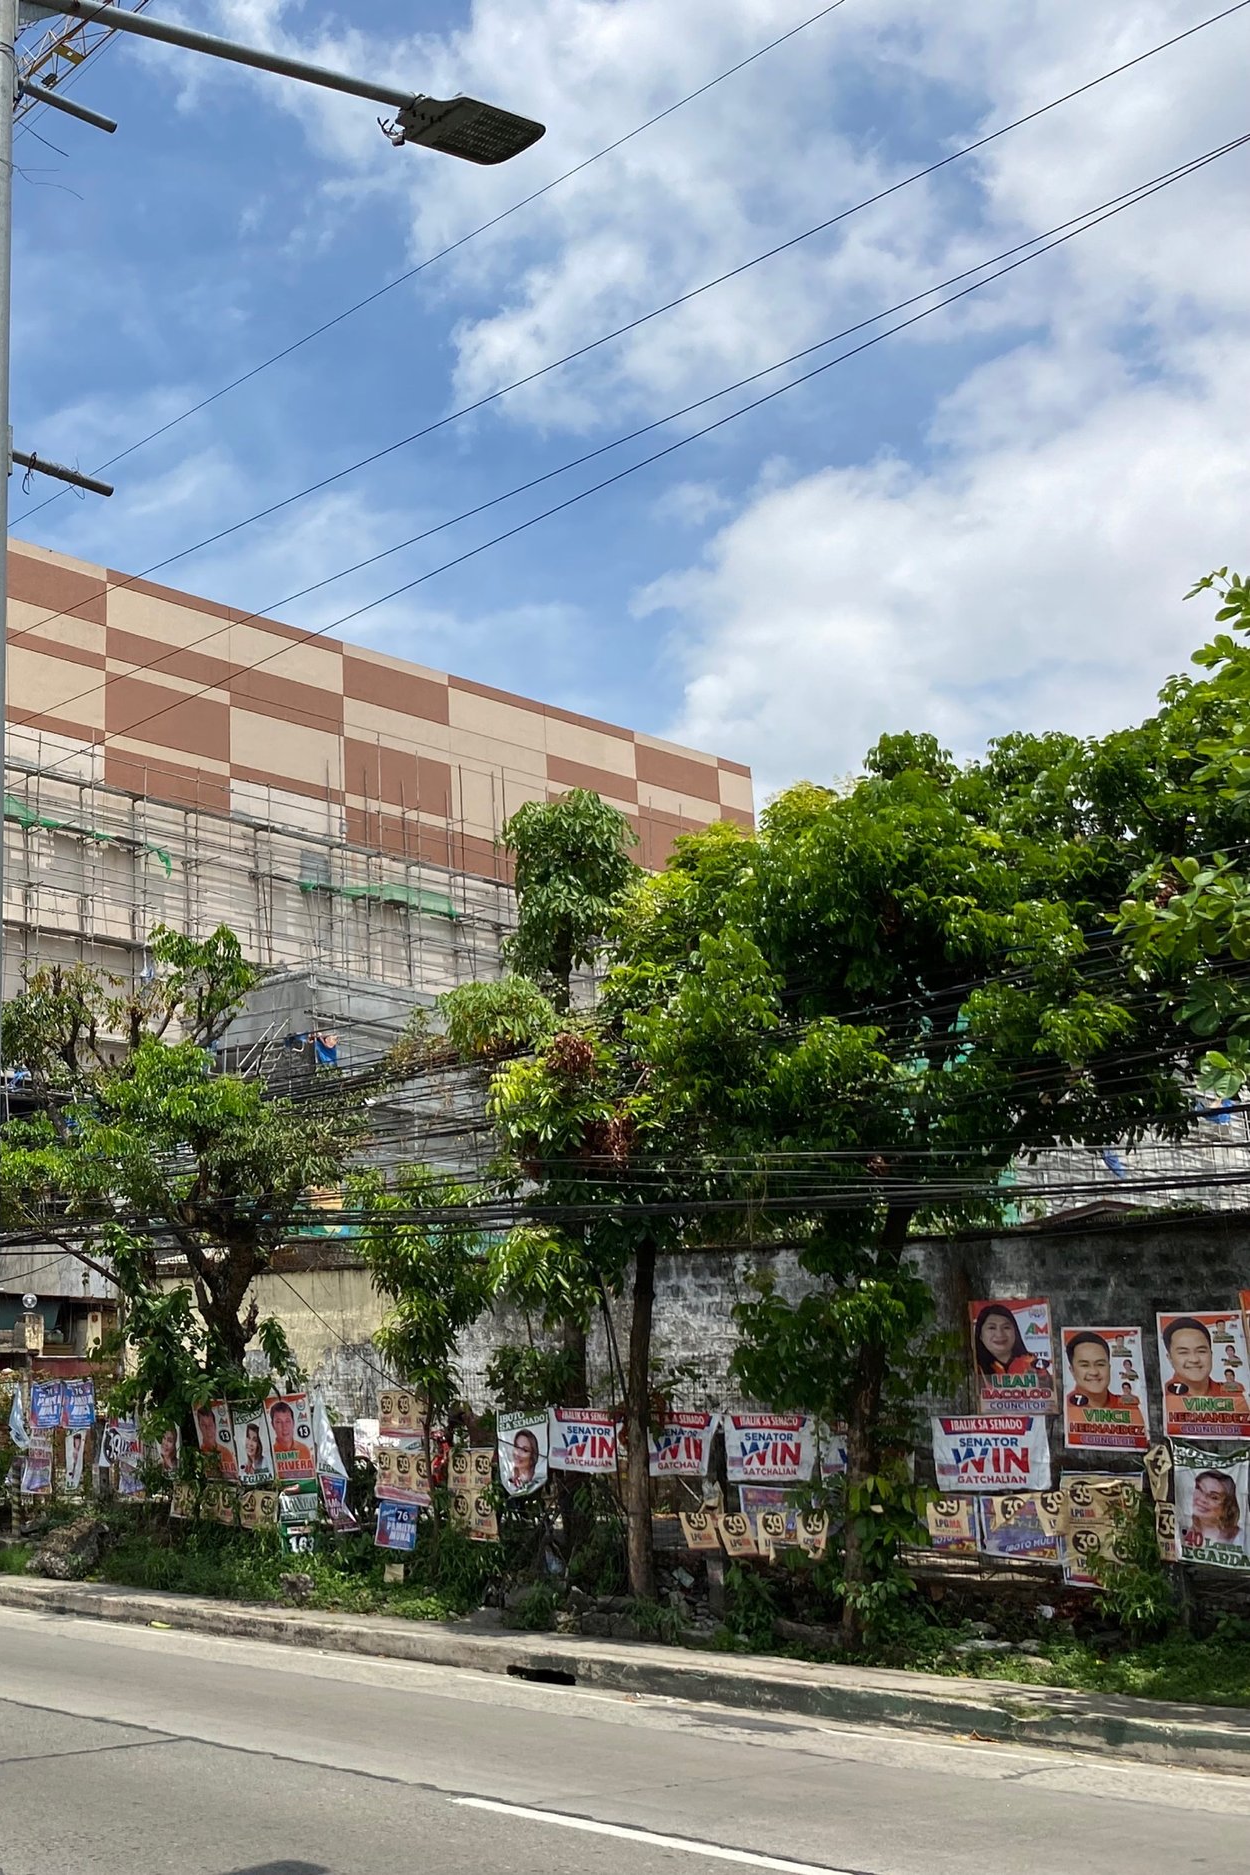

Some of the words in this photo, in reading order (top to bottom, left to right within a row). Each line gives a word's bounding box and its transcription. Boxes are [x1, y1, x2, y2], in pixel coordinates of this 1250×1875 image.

[1025, 1322, 1048, 1335] AM
[1036, 1360, 1044, 1369] 4
[992, 1374, 1037, 1388] LEAH
[981, 1389, 1052, 1400] BACOLOD
[1174, 1384, 1181, 1394] 7
[990, 1401, 1046, 1409] COUNCILOR
[1074, 1395, 1083, 1405] 7
[1183, 1397, 1234, 1411] VINCE
[500, 1411, 524, 1424] IBOTO
[740, 1416, 760, 1426] IBALIK
[762, 1416, 771, 1426] SA
[772, 1416, 798, 1427] SENADO
[1083, 1408, 1131, 1423] VINCE
[1169, 1412, 1250, 1423] HERNANDEZ
[499, 1422, 511, 1431] SA
[512, 1415, 545, 1428] SENADO
[951, 1419, 976, 1431] IBALIK
[978, 1419, 988, 1430] SA
[990, 1419, 1023, 1430] SENADO
[1070, 1422, 1146, 1435] HERNANDEZ
[299, 1427, 309, 1437] 13
[567, 1426, 611, 1436] SENATOR
[1181, 1425, 1241, 1434] COUNCILOR
[220, 1431, 230, 1441] 13
[744, 1432, 793, 1441] SENATOR
[959, 1437, 1018, 1447] SENATOR
[562, 1433, 615, 1458] WIN
[740, 1442, 802, 1466] WIN
[951, 1447, 1030, 1473] WIN
[278, 1460, 313, 1470] RIVERA
[455, 1456, 466, 1472] 39
[477, 1457, 490, 1473] 39
[565, 1457, 612, 1467] GATCHALIAN
[742, 1467, 797, 1476] GATCHALIAN
[958, 1475, 1027, 1484] GATCHALIAN
[1072, 1484, 1093, 1504] 39
[477, 1498, 492, 1514] 39
[397, 1510, 408, 1521] 76
[690, 1513, 707, 1529] 39
[727, 1516, 746, 1532] 39
[765, 1515, 783, 1532] 39
[806, 1513, 824, 1532] 39
[1185, 1531, 1203, 1547] 40
[1044, 1549, 1057, 1559] 73
